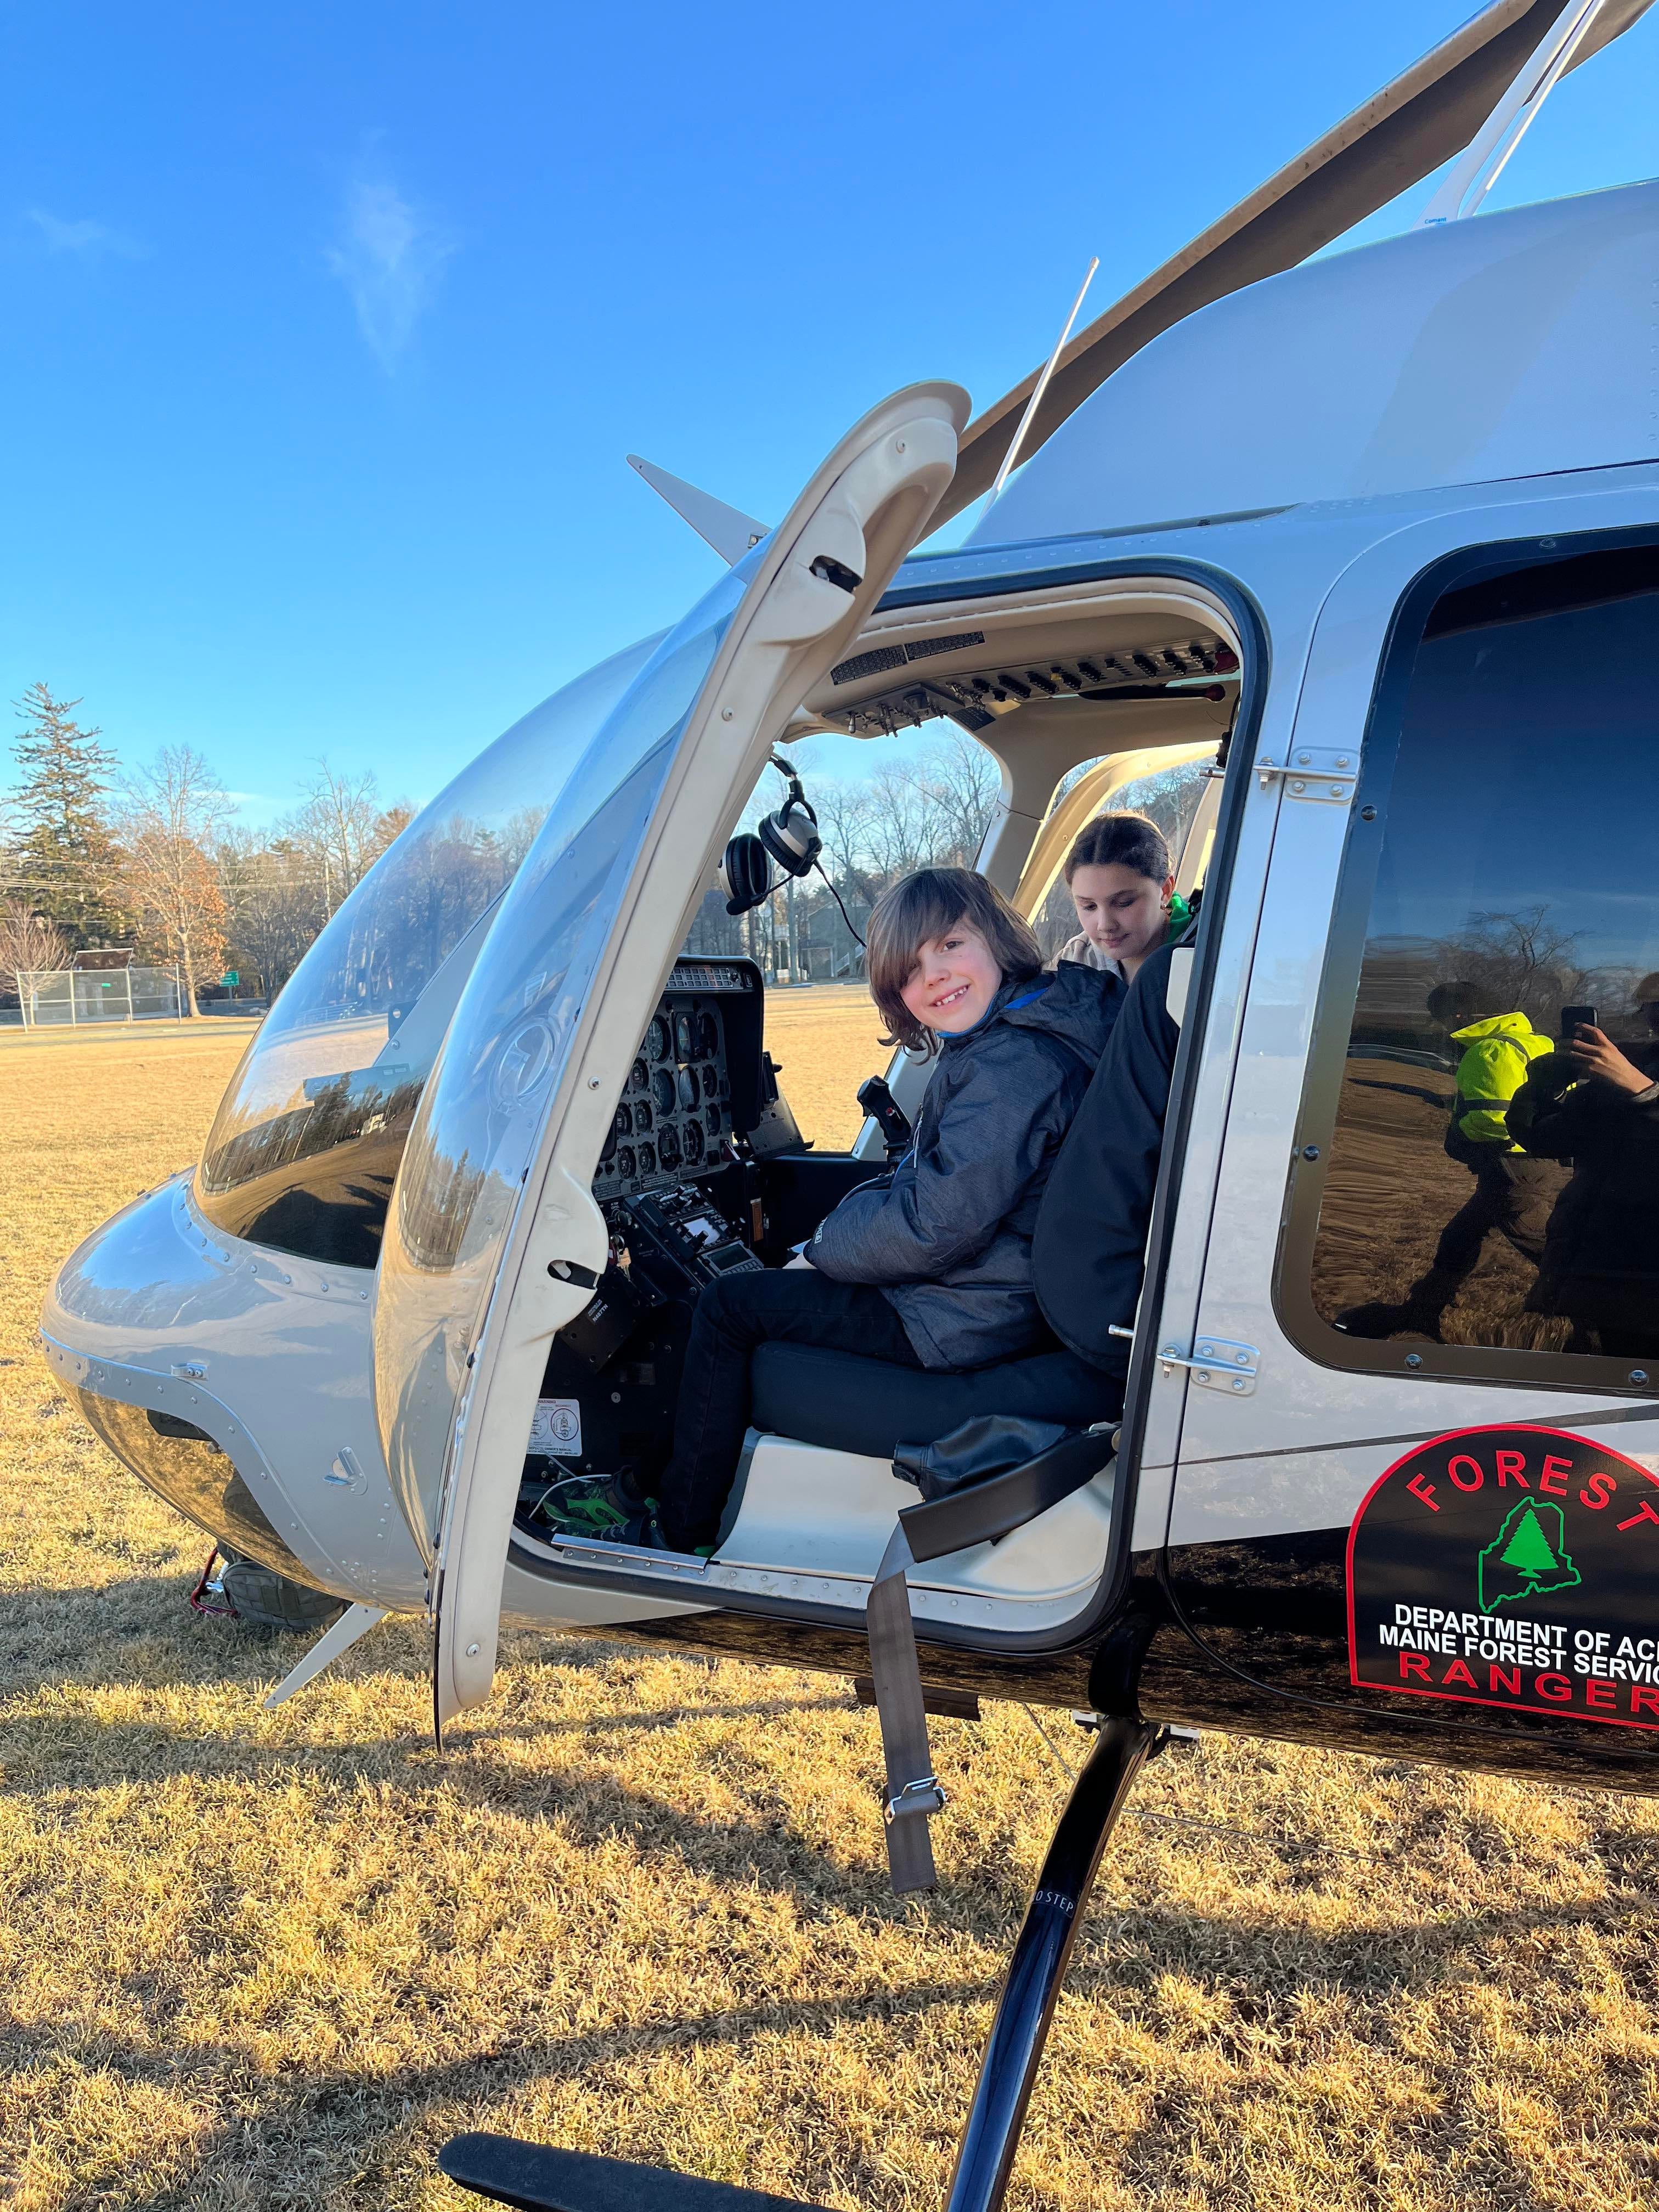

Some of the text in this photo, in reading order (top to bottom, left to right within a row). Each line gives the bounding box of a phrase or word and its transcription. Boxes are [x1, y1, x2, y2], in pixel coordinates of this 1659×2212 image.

[1406, 1449, 1659, 1531] FOREST
[1379, 1624, 1457, 1655] MAINE
[1465, 1636, 1567, 1670] FOREST
[1395, 1604, 1659, 1662] DEPARTMENT OF AC
[1399, 1651, 1659, 1716] RANGER
[1035, 1890, 1074, 1912] O STEP
